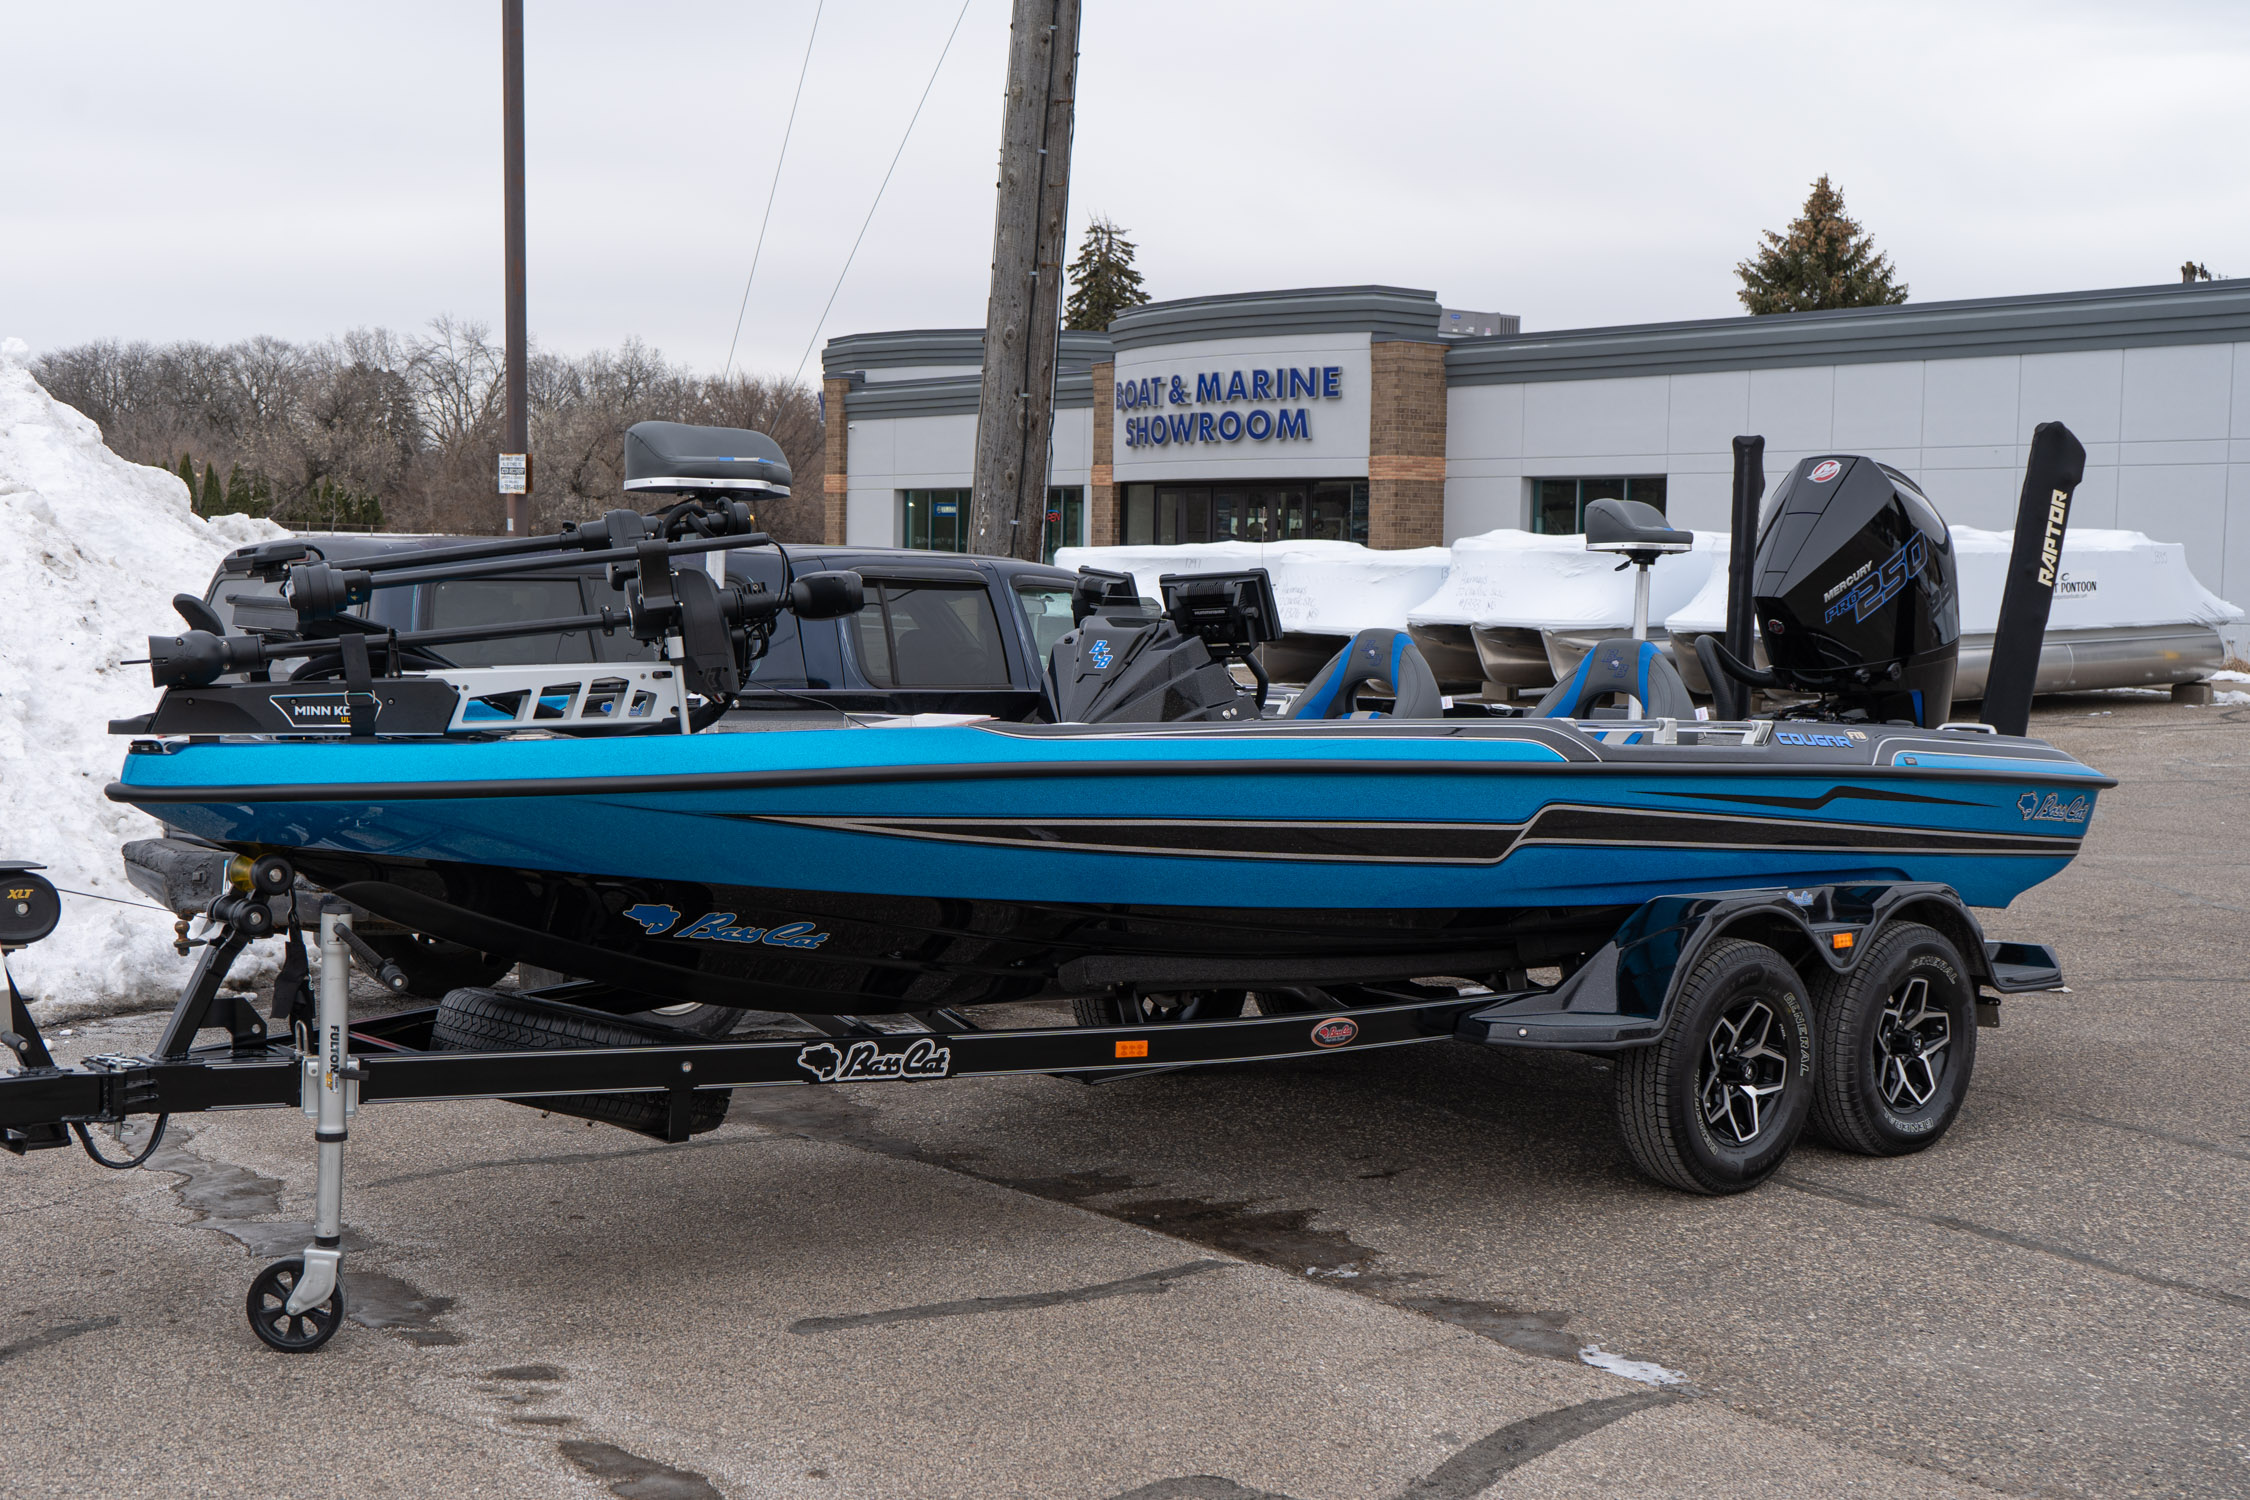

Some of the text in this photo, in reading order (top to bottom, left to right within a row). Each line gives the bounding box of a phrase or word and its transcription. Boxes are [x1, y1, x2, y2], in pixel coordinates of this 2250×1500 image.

[1168, 374, 1190, 405] &
[1196, 366, 1342, 404] MARINE
[1126, 408, 1312, 447] SHOWROOM
[1046, 512, 1061, 523] PEN
[2037, 489, 2068, 588] RAPTOR
[1823, 560, 1873, 603] MERCURY
[1825, 529, 1928, 624] PRO 250
[2061, 581, 2097, 593] PONTOON
[294, 705, 351, 716] MINN KO
[1775, 732, 1854, 749] COUGAR
[2032, 792, 2090, 823] Bass Cat
[7, 889, 34, 899] XLT
[673, 912, 830, 949] Bass Cat
[1909, 955, 1958, 985] GENERAL
[329, 1024, 340, 1074] FULTON
[1784, 992, 1811, 1077] GENERAL
[835, 1038, 951, 1081] Bass Cat
[1883, 1106, 1935, 1132] GENERAL
